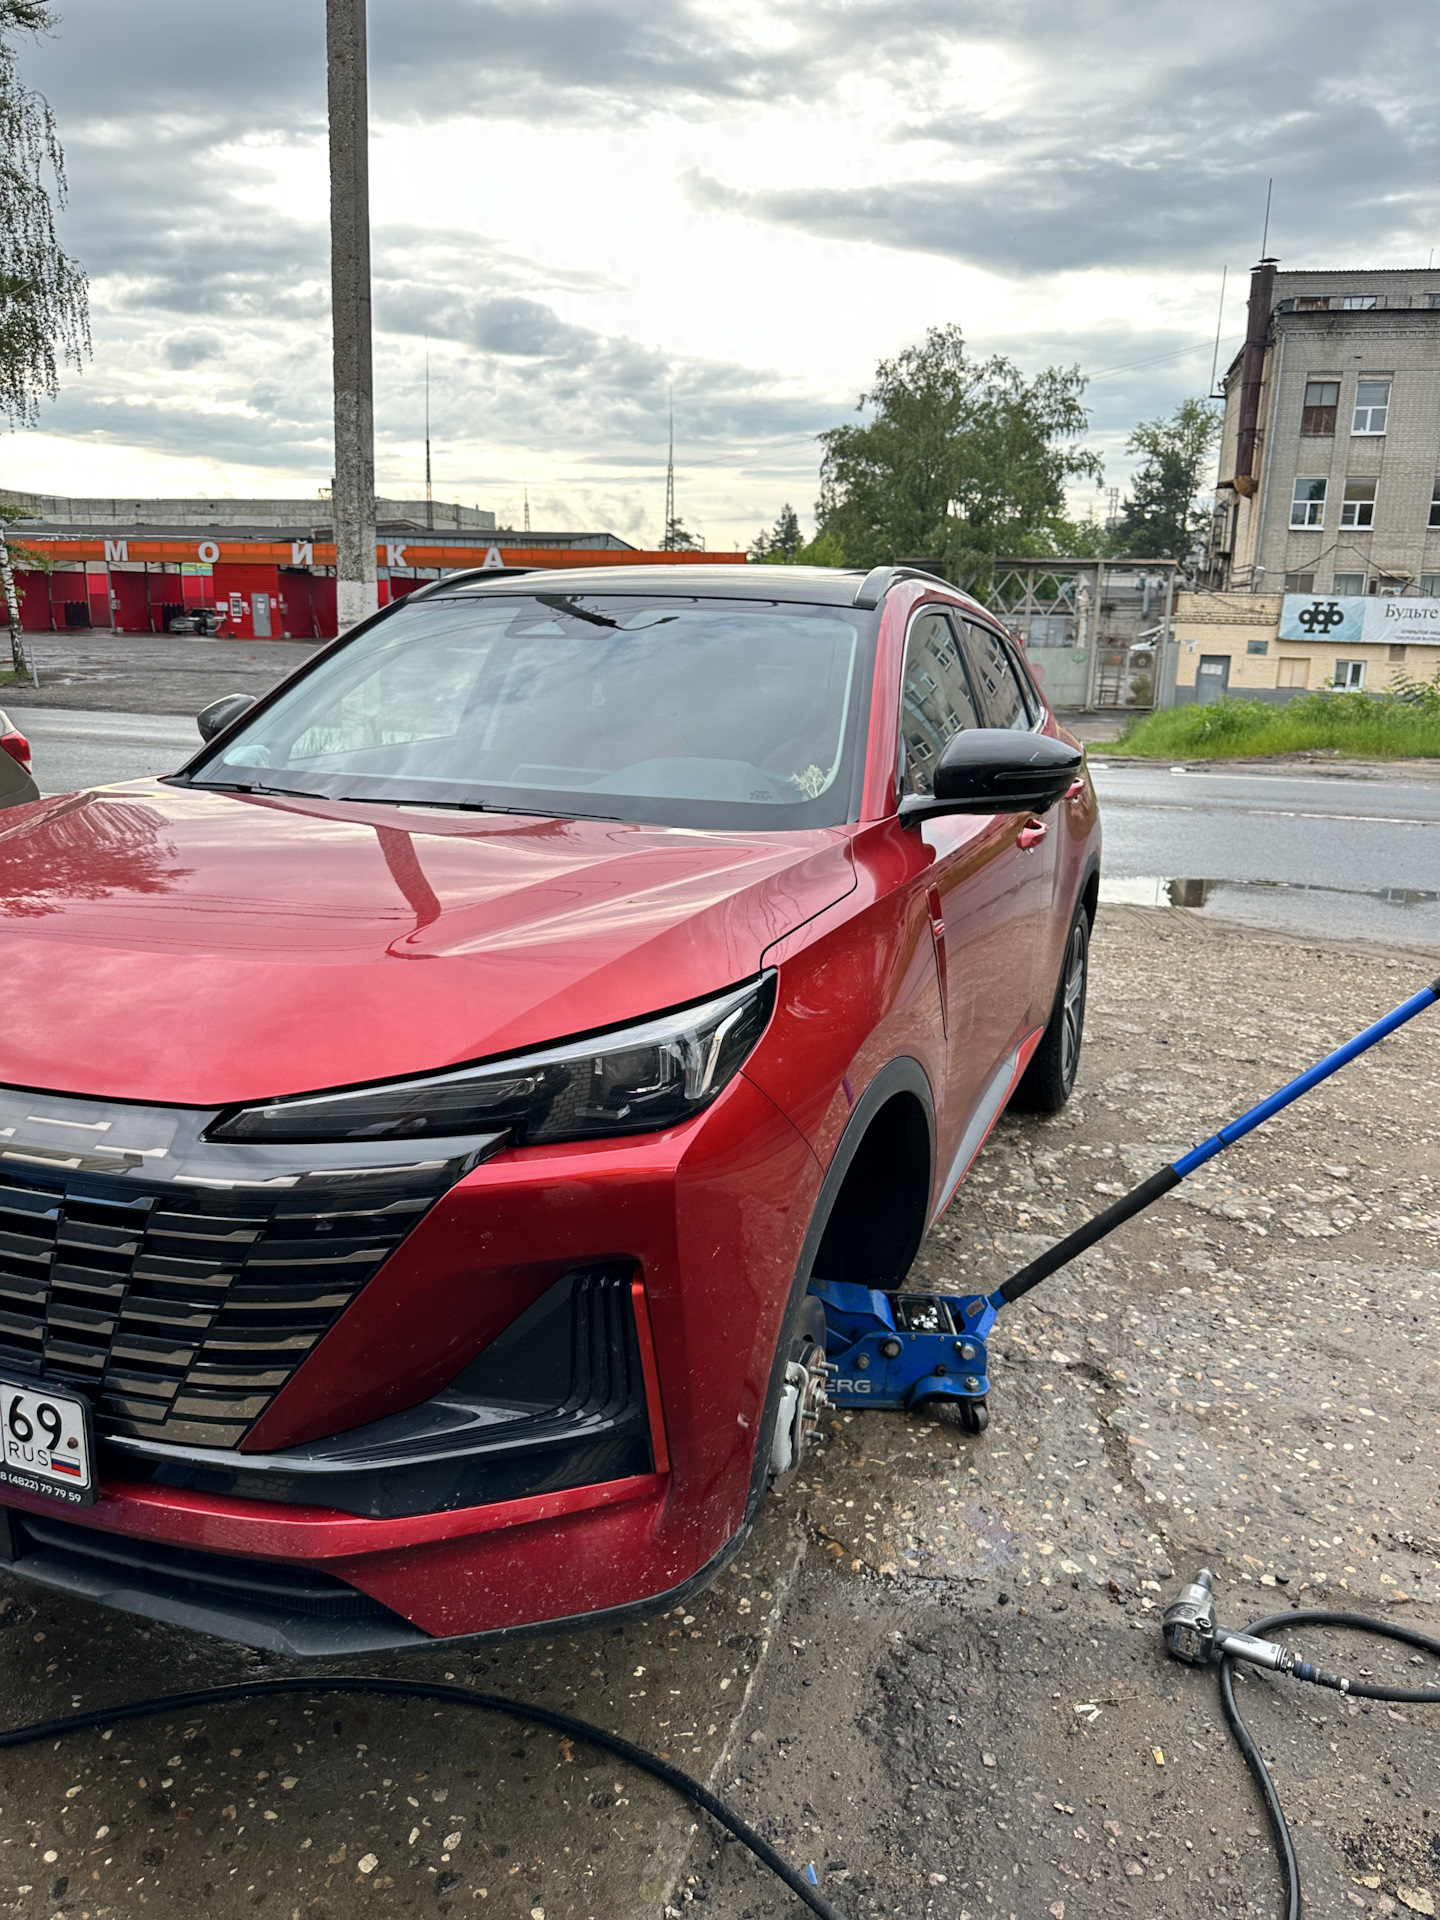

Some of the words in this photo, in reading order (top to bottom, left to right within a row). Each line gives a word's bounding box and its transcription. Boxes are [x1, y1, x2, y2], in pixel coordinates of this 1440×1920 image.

[104, 540, 504, 567] МОЙКА
[1385, 604, 1438, 621] Будьте
[9, 1395, 62, 1450] 69
[8, 1440, 49, 1467] RUS
[8, 1473, 39, 1491] (4822)
[41, 1483, 53, 1494] 79
[55, 1488, 67, 1498] 79
[69, 1492, 82, 1503] 59
